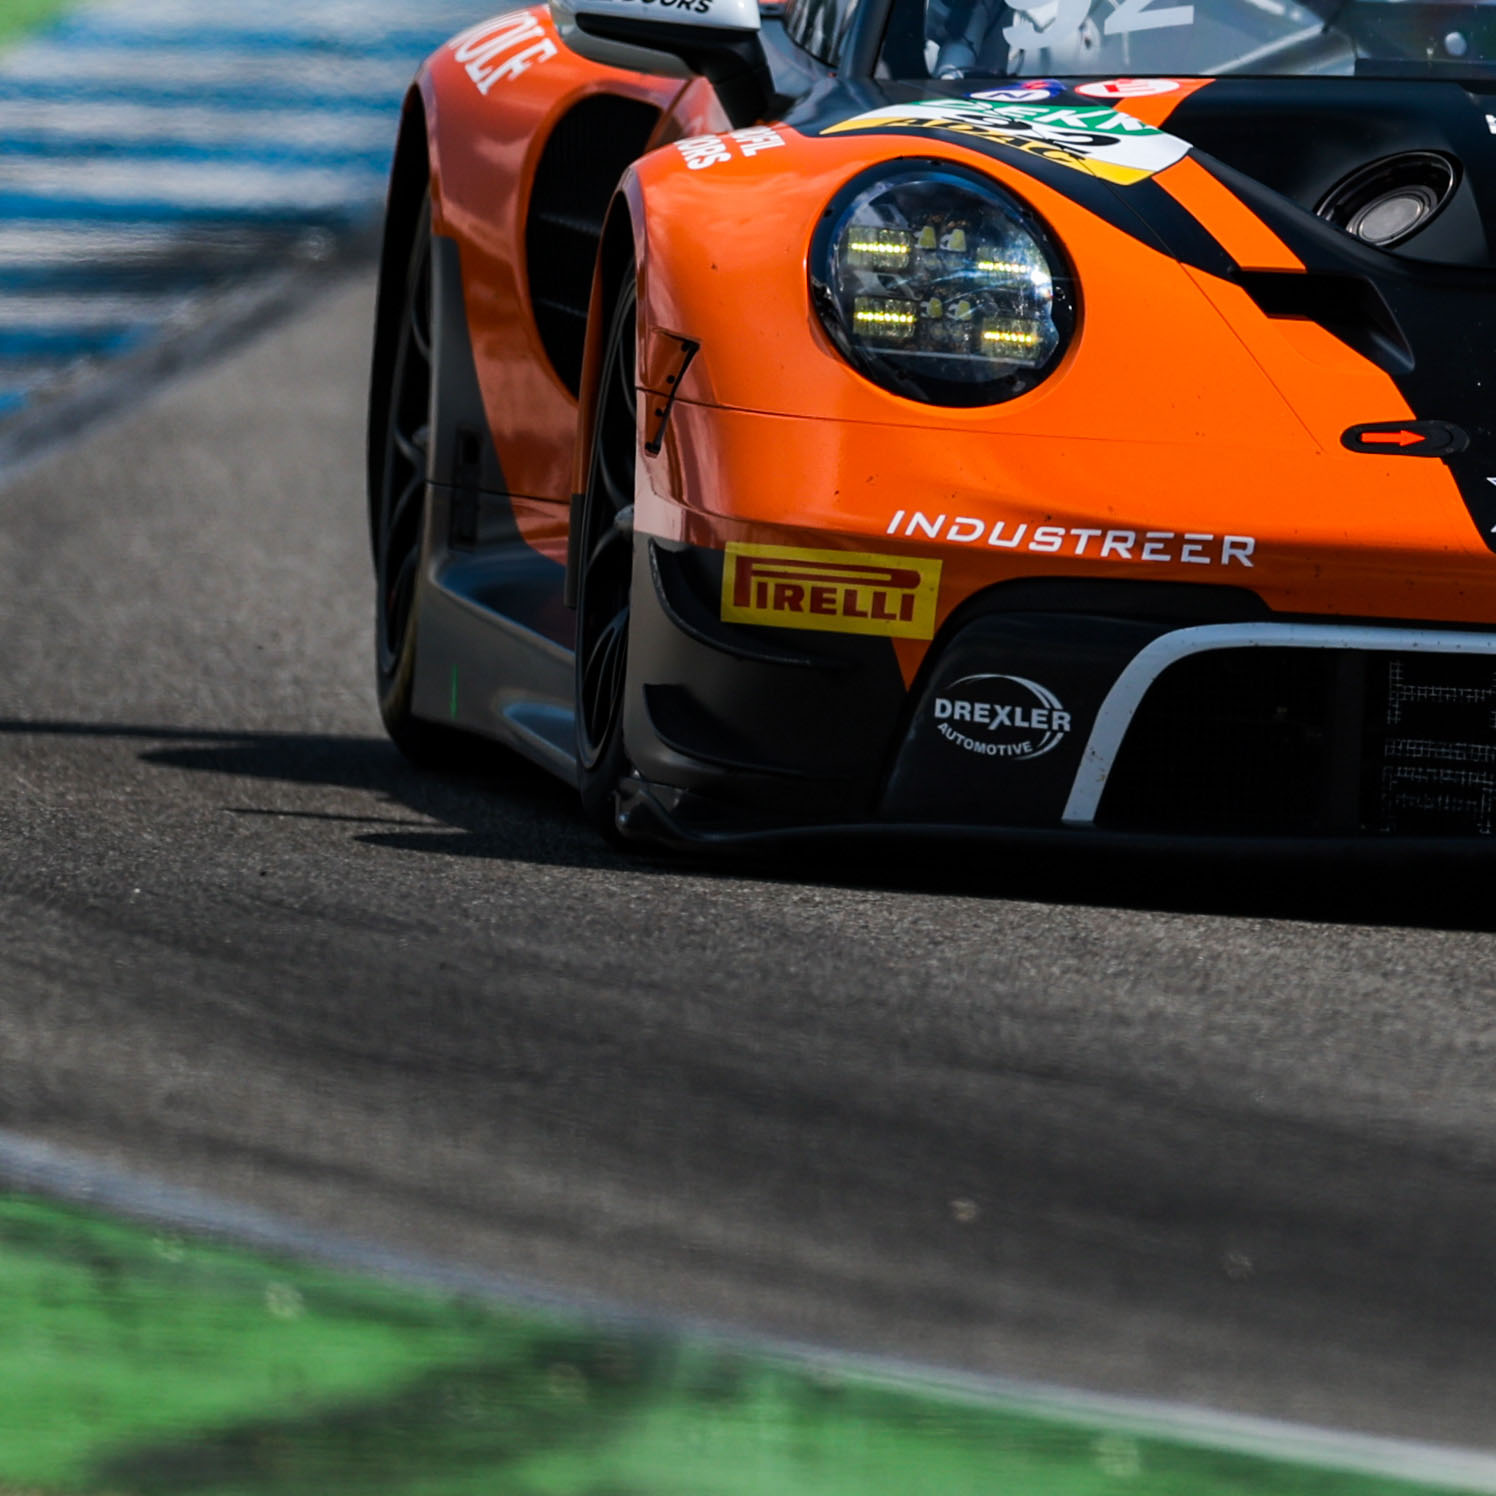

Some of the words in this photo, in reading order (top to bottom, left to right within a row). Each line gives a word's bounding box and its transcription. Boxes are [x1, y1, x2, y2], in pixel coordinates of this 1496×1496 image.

[886, 510, 1256, 568] INDUSTREER
[733, 555, 921, 622] PIRELLI
[934, 698, 1072, 733] DREXLER
[937, 721, 1034, 757] AUTOMOTIVE
